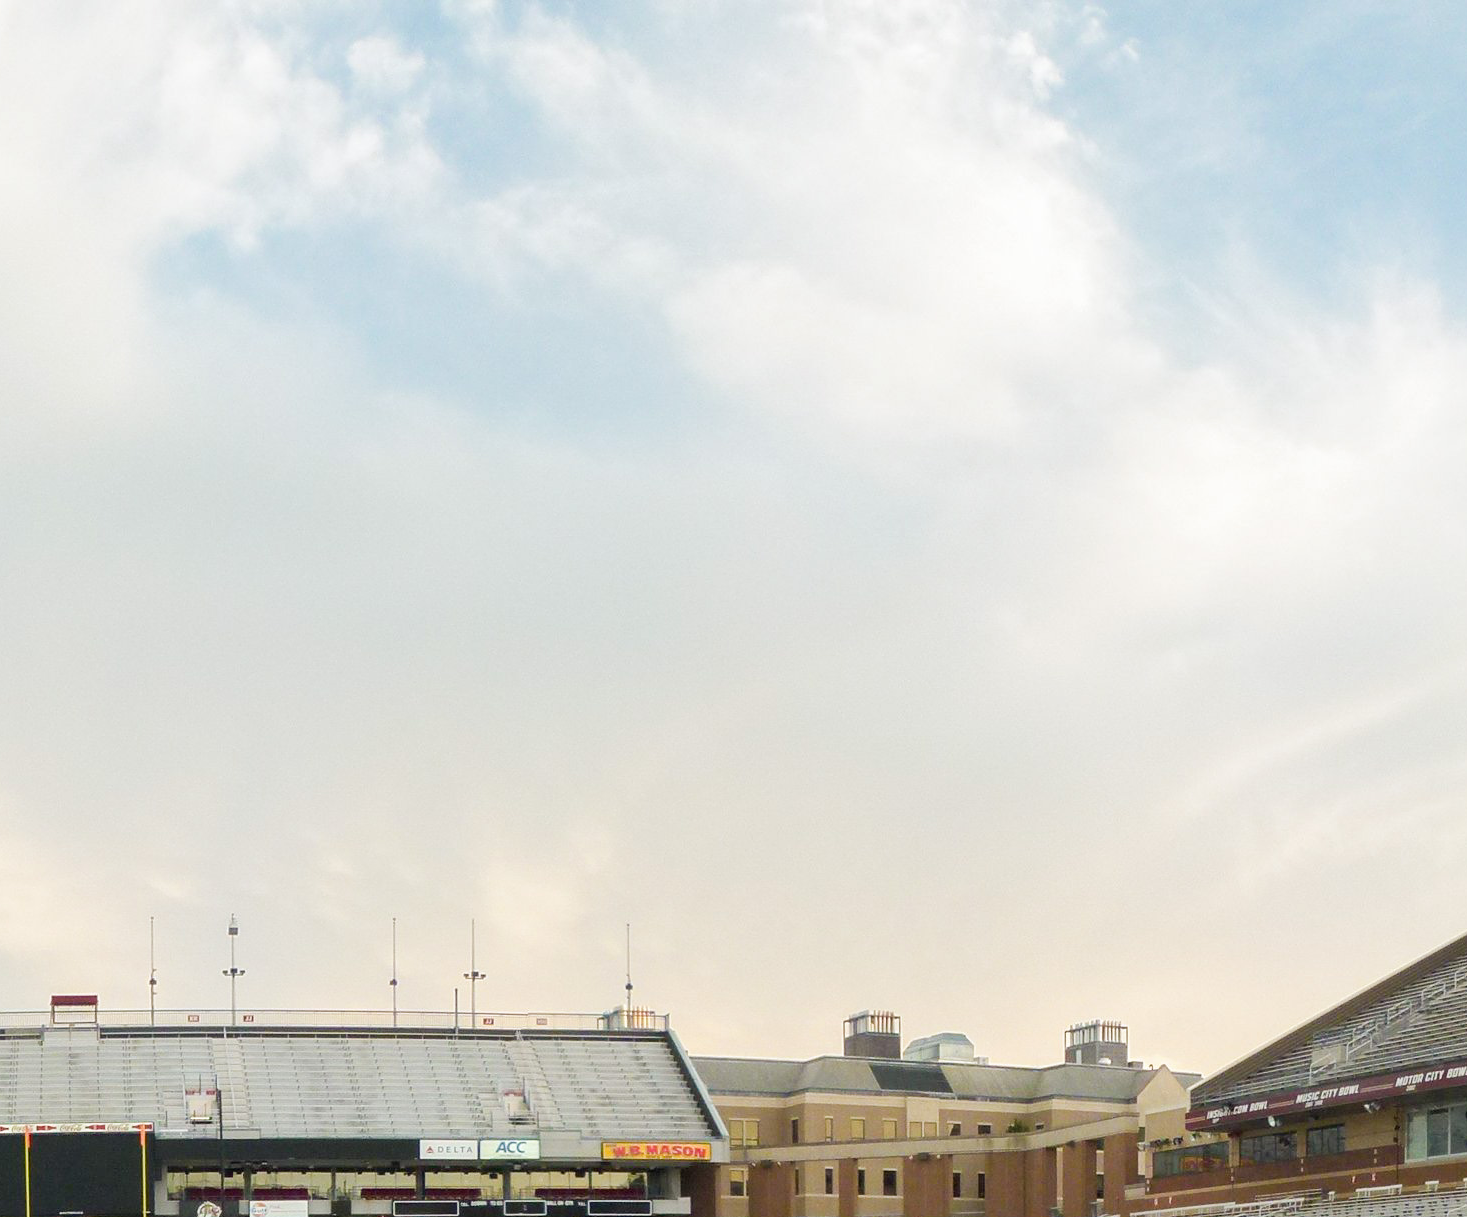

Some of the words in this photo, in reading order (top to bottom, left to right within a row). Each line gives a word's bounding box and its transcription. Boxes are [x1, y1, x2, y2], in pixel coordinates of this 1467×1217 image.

[1395, 1072, 1423, 1087] MOTOR
[1425, 1070, 1445, 1082] CITY
[1295, 1091, 1320, 1104] MUSIC
[1320, 1087, 1338, 1098] CITY
[1338, 1084, 1359, 1096] BOWL
[1249, 1101, 1268, 1112] BOWL
[496, 1141, 526, 1153] ACC
[646, 1145, 706, 1157] MASON
